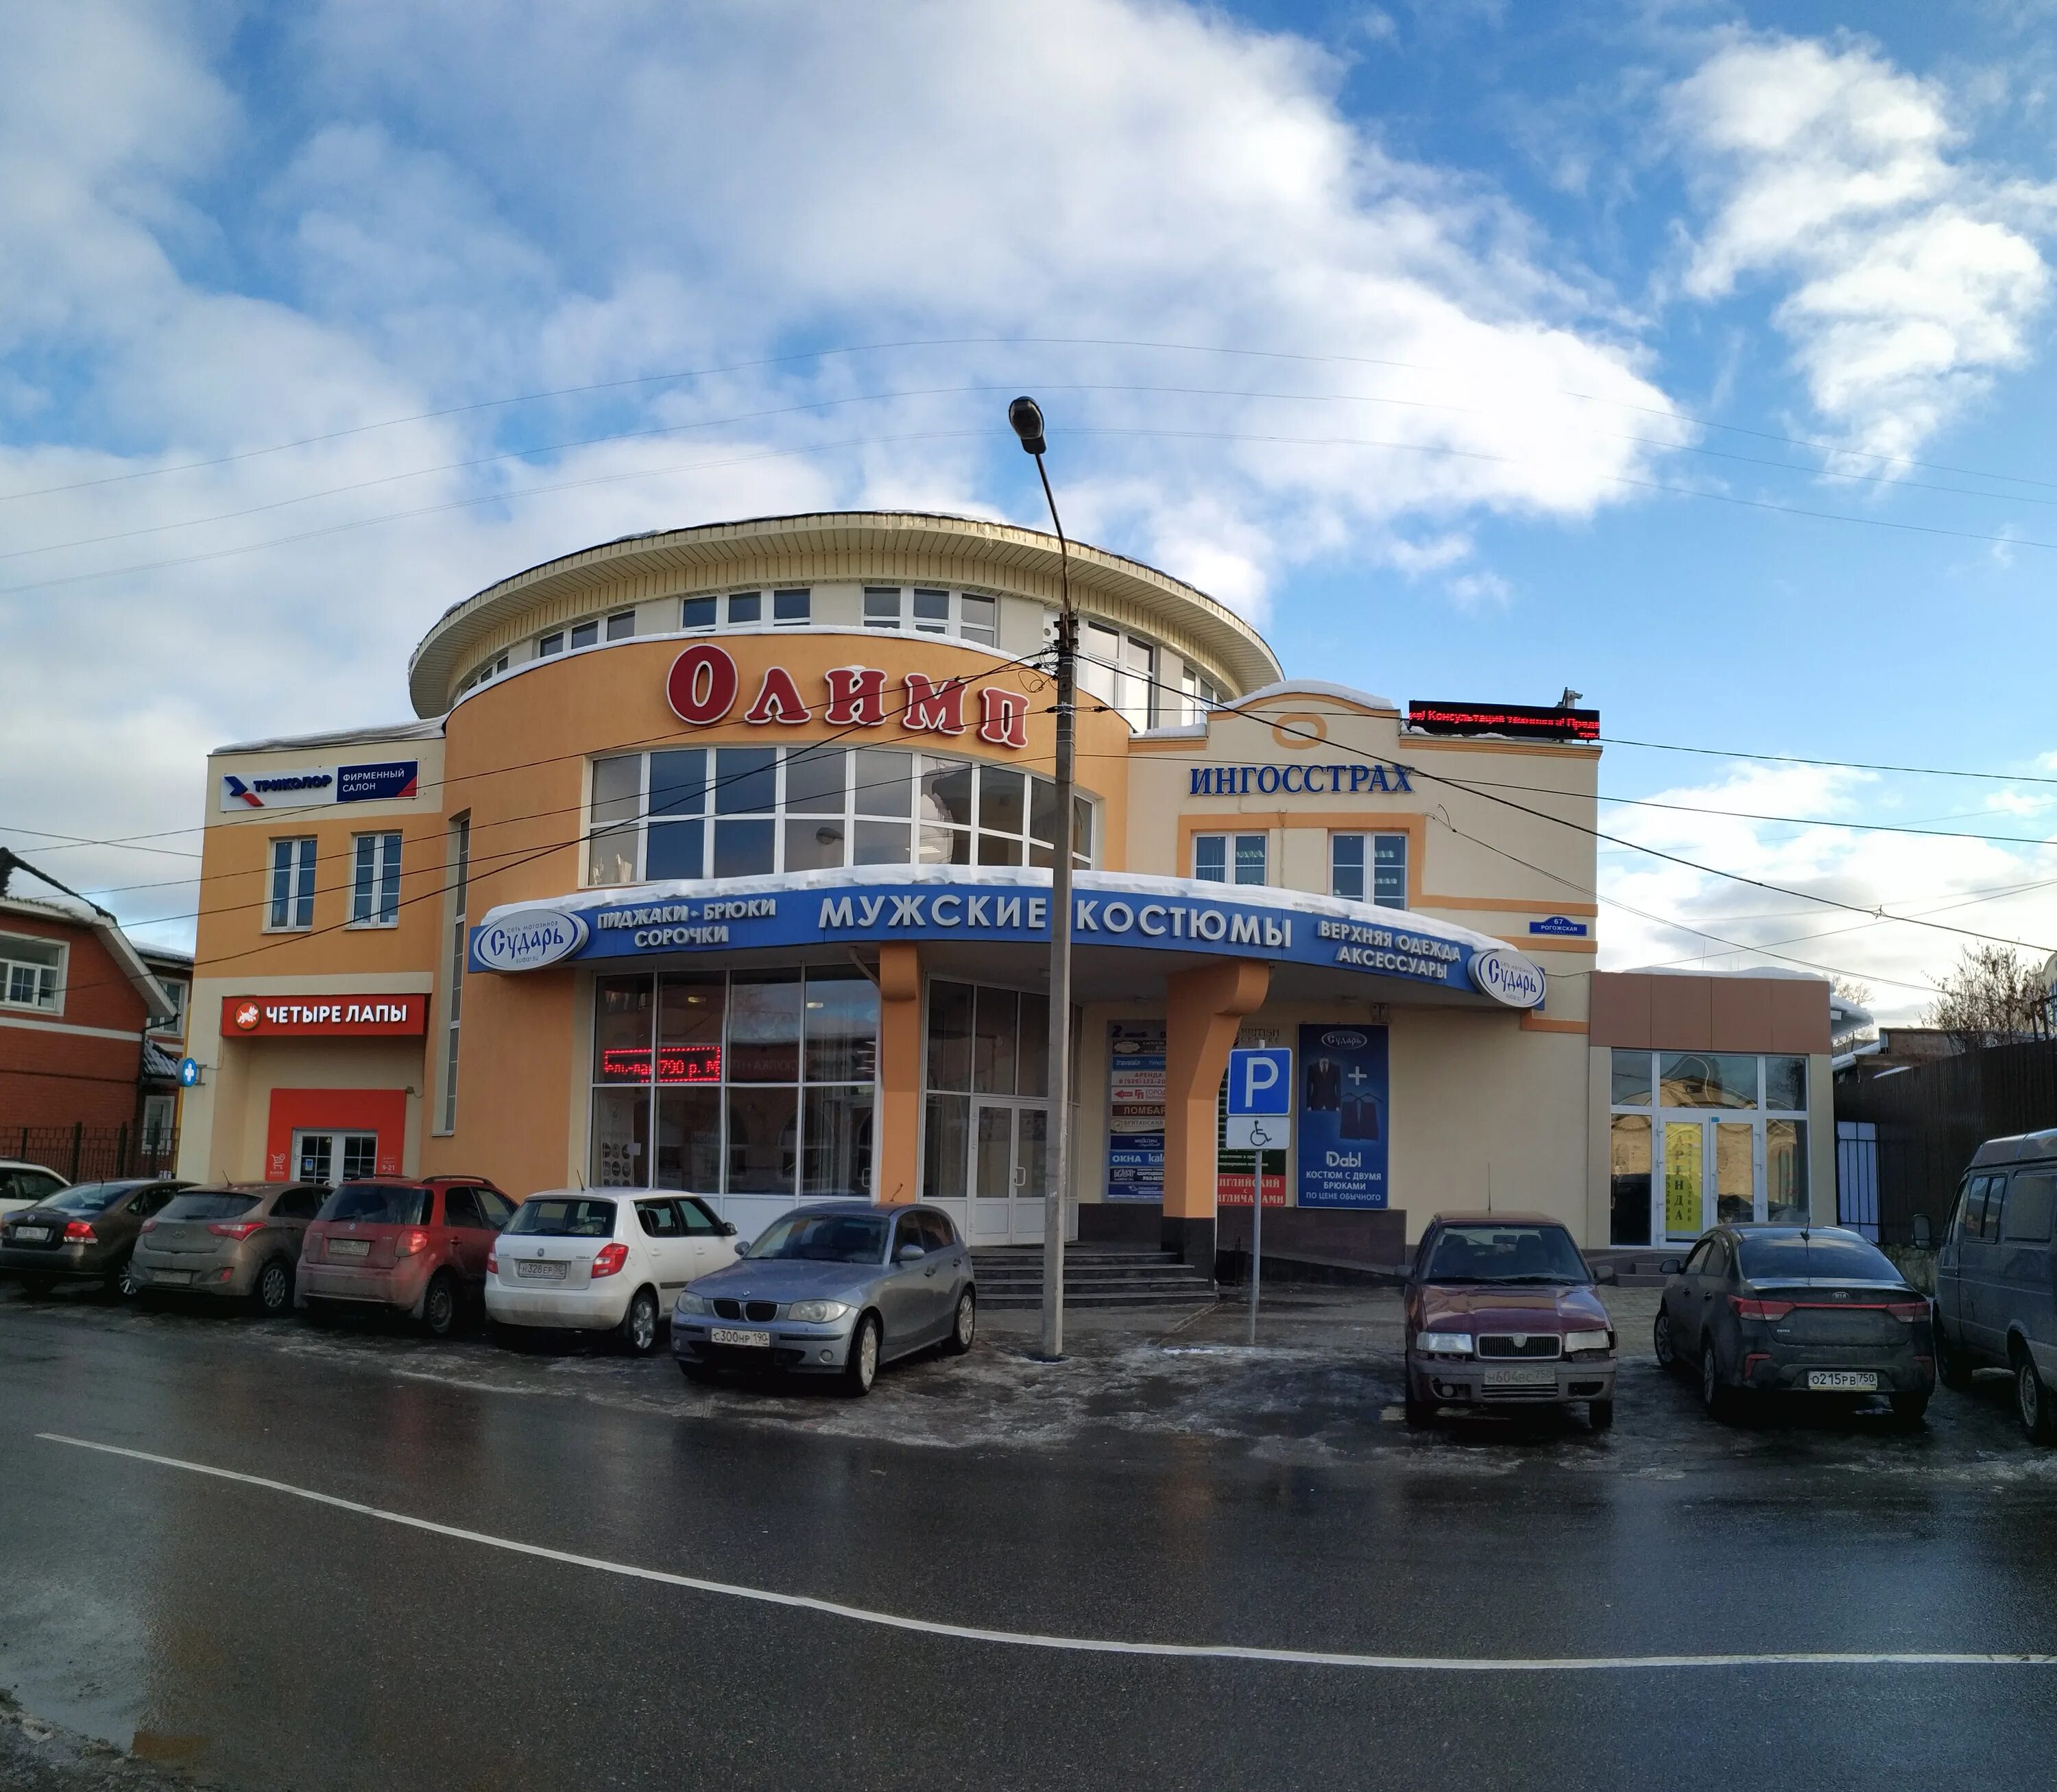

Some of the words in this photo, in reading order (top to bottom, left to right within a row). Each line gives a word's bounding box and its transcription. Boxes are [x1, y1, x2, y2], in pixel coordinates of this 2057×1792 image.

[253, 775, 333, 792] ТРИКОЛОР
[343, 768, 405, 782] ФИРМЕННЫЙ
[1190, 763, 1415, 795] ИНГОССТРАХ
[342, 783, 376, 792] САЛОН
[597, 904, 688, 930] ПИДЖАКИ
[703, 898, 777, 921] БРЮКИ
[818, 894, 1047, 930] МУЖСКИЕ
[1076, 899, 1292, 947] КОСТЮМЫ
[523, 921, 558, 930] магазинов
[490, 927, 564, 960] Сударь
[634, 925, 729, 948] СОРОЧКИ
[1319, 920, 1392, 948] ВЕРХНЯЯ
[1395, 934, 1461, 962] ОДЕЖДА
[1336, 945, 1447, 979] АКСЕССУАРЫ
[1489, 958, 1537, 999] Сударь
[266, 1005, 341, 1024] ЧЕТЫРЕ
[346, 1004, 407, 1022] ЛАПЫ
[1244, 1056, 1279, 1108] P
[1112, 1154, 1142, 1163] ОКНА
[1148, 1153, 1165, 1163] kal
[1326, 1150, 1362, 1167] Dabl
[1218, 1176, 1280, 1188] НГЛИЙСКИЙ
[1306, 1170, 1343, 1178] КОСТЮМ
[1352, 1172, 1382, 1180] ДВУМЯ
[1323, 1181, 1367, 1190] БРЮКАМИ
[1339, 1193, 1381, 1201] ОБЫЧНОГО
[1812, 1373, 1856, 1385] О215РВ
[1857, 1373, 1875, 1383] 750
